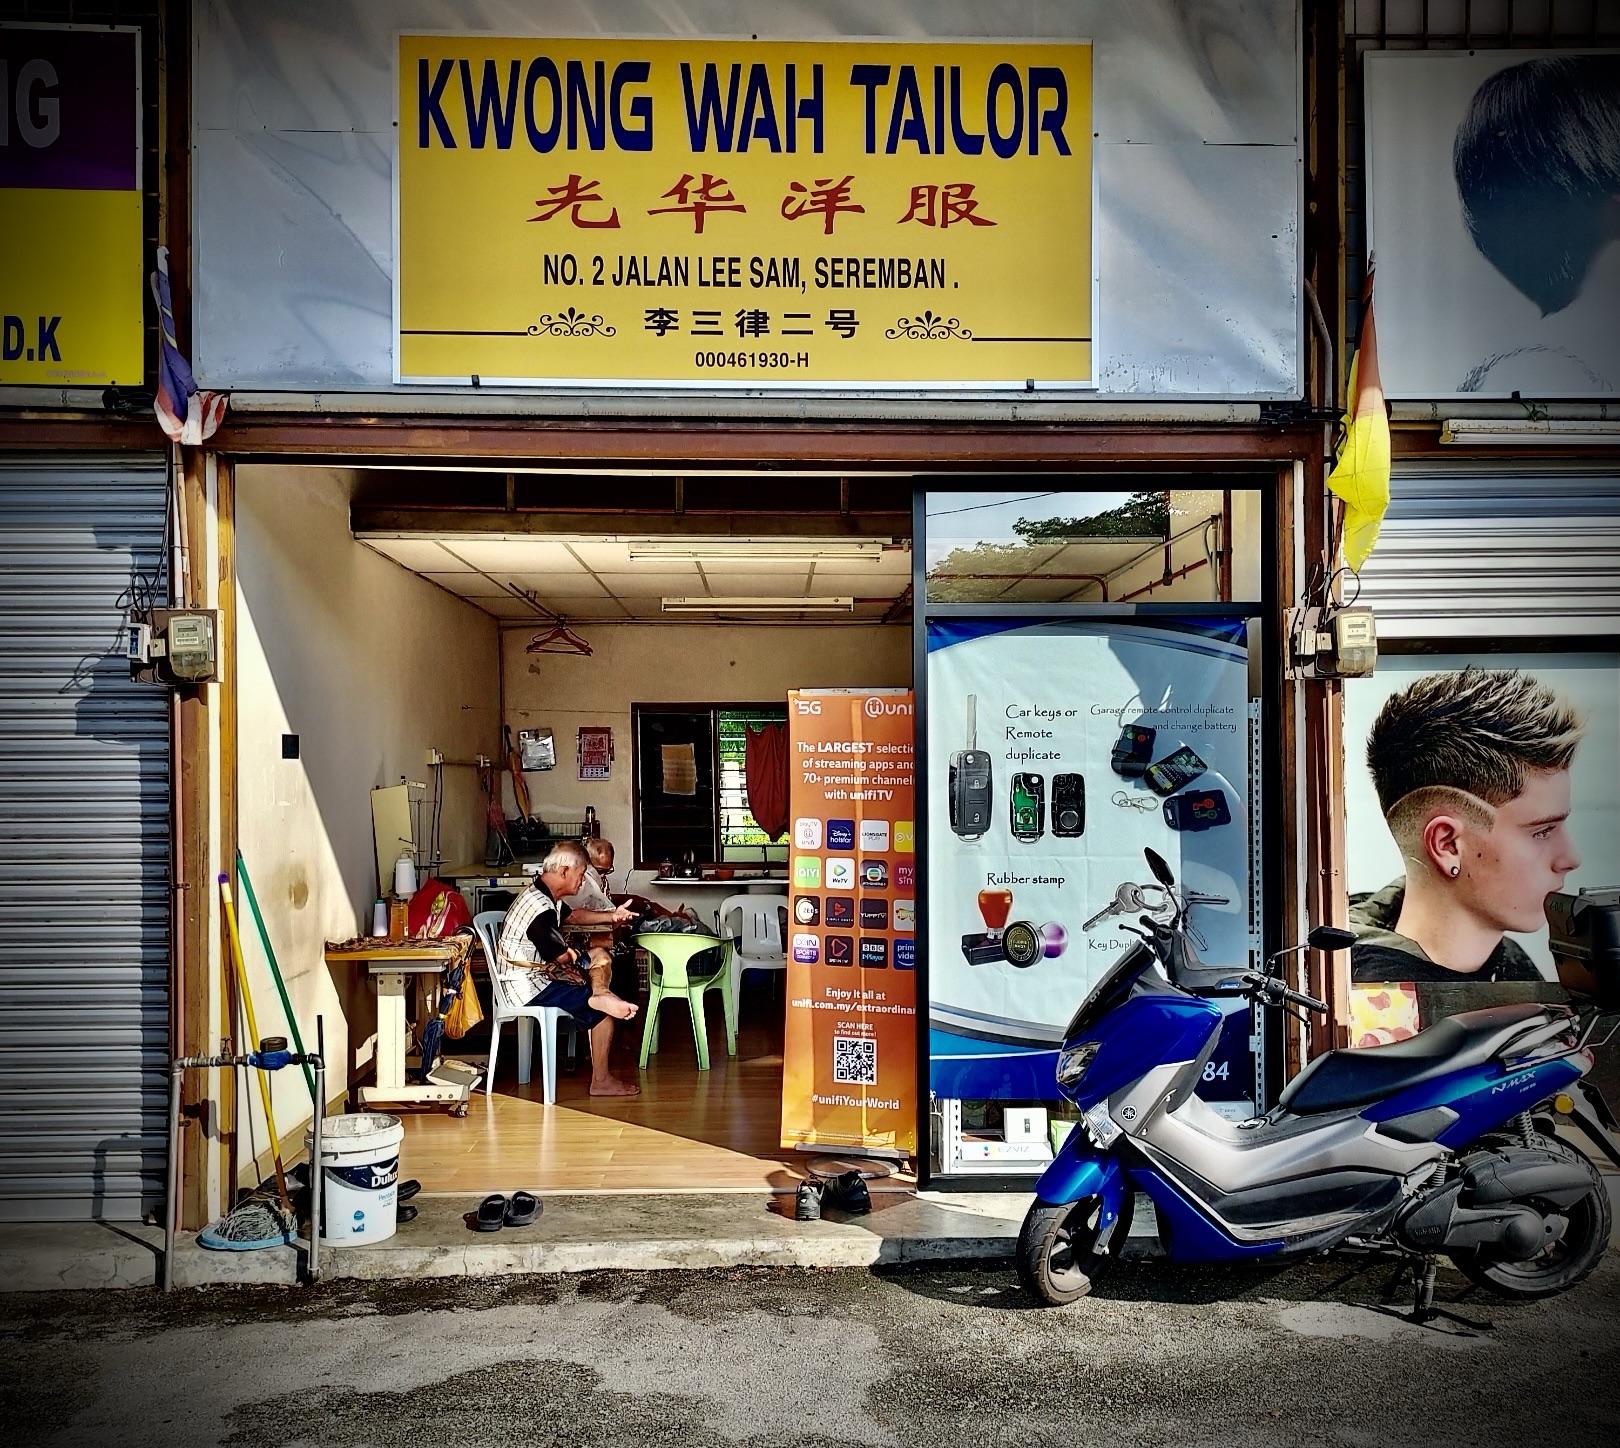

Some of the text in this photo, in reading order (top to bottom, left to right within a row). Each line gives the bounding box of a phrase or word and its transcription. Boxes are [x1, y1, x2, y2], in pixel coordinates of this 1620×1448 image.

[418, 56, 1072, 159] KWONG WAH TAILOR
[526, 173, 998, 235] 光华洋服
[543, 254, 584, 286] NO.
[592, 255, 605, 286] 2
[612, 256, 689, 287] JALAN
[698, 257, 742, 288] LEE
[750, 257, 807, 294] SAM,
[644, 307, 860, 339] 李三律二号
[2, 315, 62, 362] D.K
[695, 351, 810, 368] 000461930-H
[798, 700, 822, 715] 5G
[1005, 704, 1078, 723] Car keys or
[1090, 704, 1234, 718] Garage remote control duplicate
[1005, 726, 1053, 740] Remote
[1152, 720, 1237, 733] and change battery
[797, 742, 815, 753] The
[817, 742, 874, 753] LARGEST
[1005, 747, 1062, 765] duplicate
[802, 758, 814, 768] of
[815, 759, 866, 771] streaming
[869, 761, 894, 771] apps
[803, 773, 914, 786] 70+ premium channel
[824, 789, 848, 800] with
[987, 872, 1065, 889] Rubber stamp
[862, 944, 885, 952] BBC
[1088, 939, 1135, 951] Key Dupl
[825, 987, 887, 1001] Enjoy it all at
[837, 1021, 874, 1031] SCAN HERE
[1202, 1061, 1230, 1081] 84
[812, 1094, 900, 1110] #unifiYourWorld
